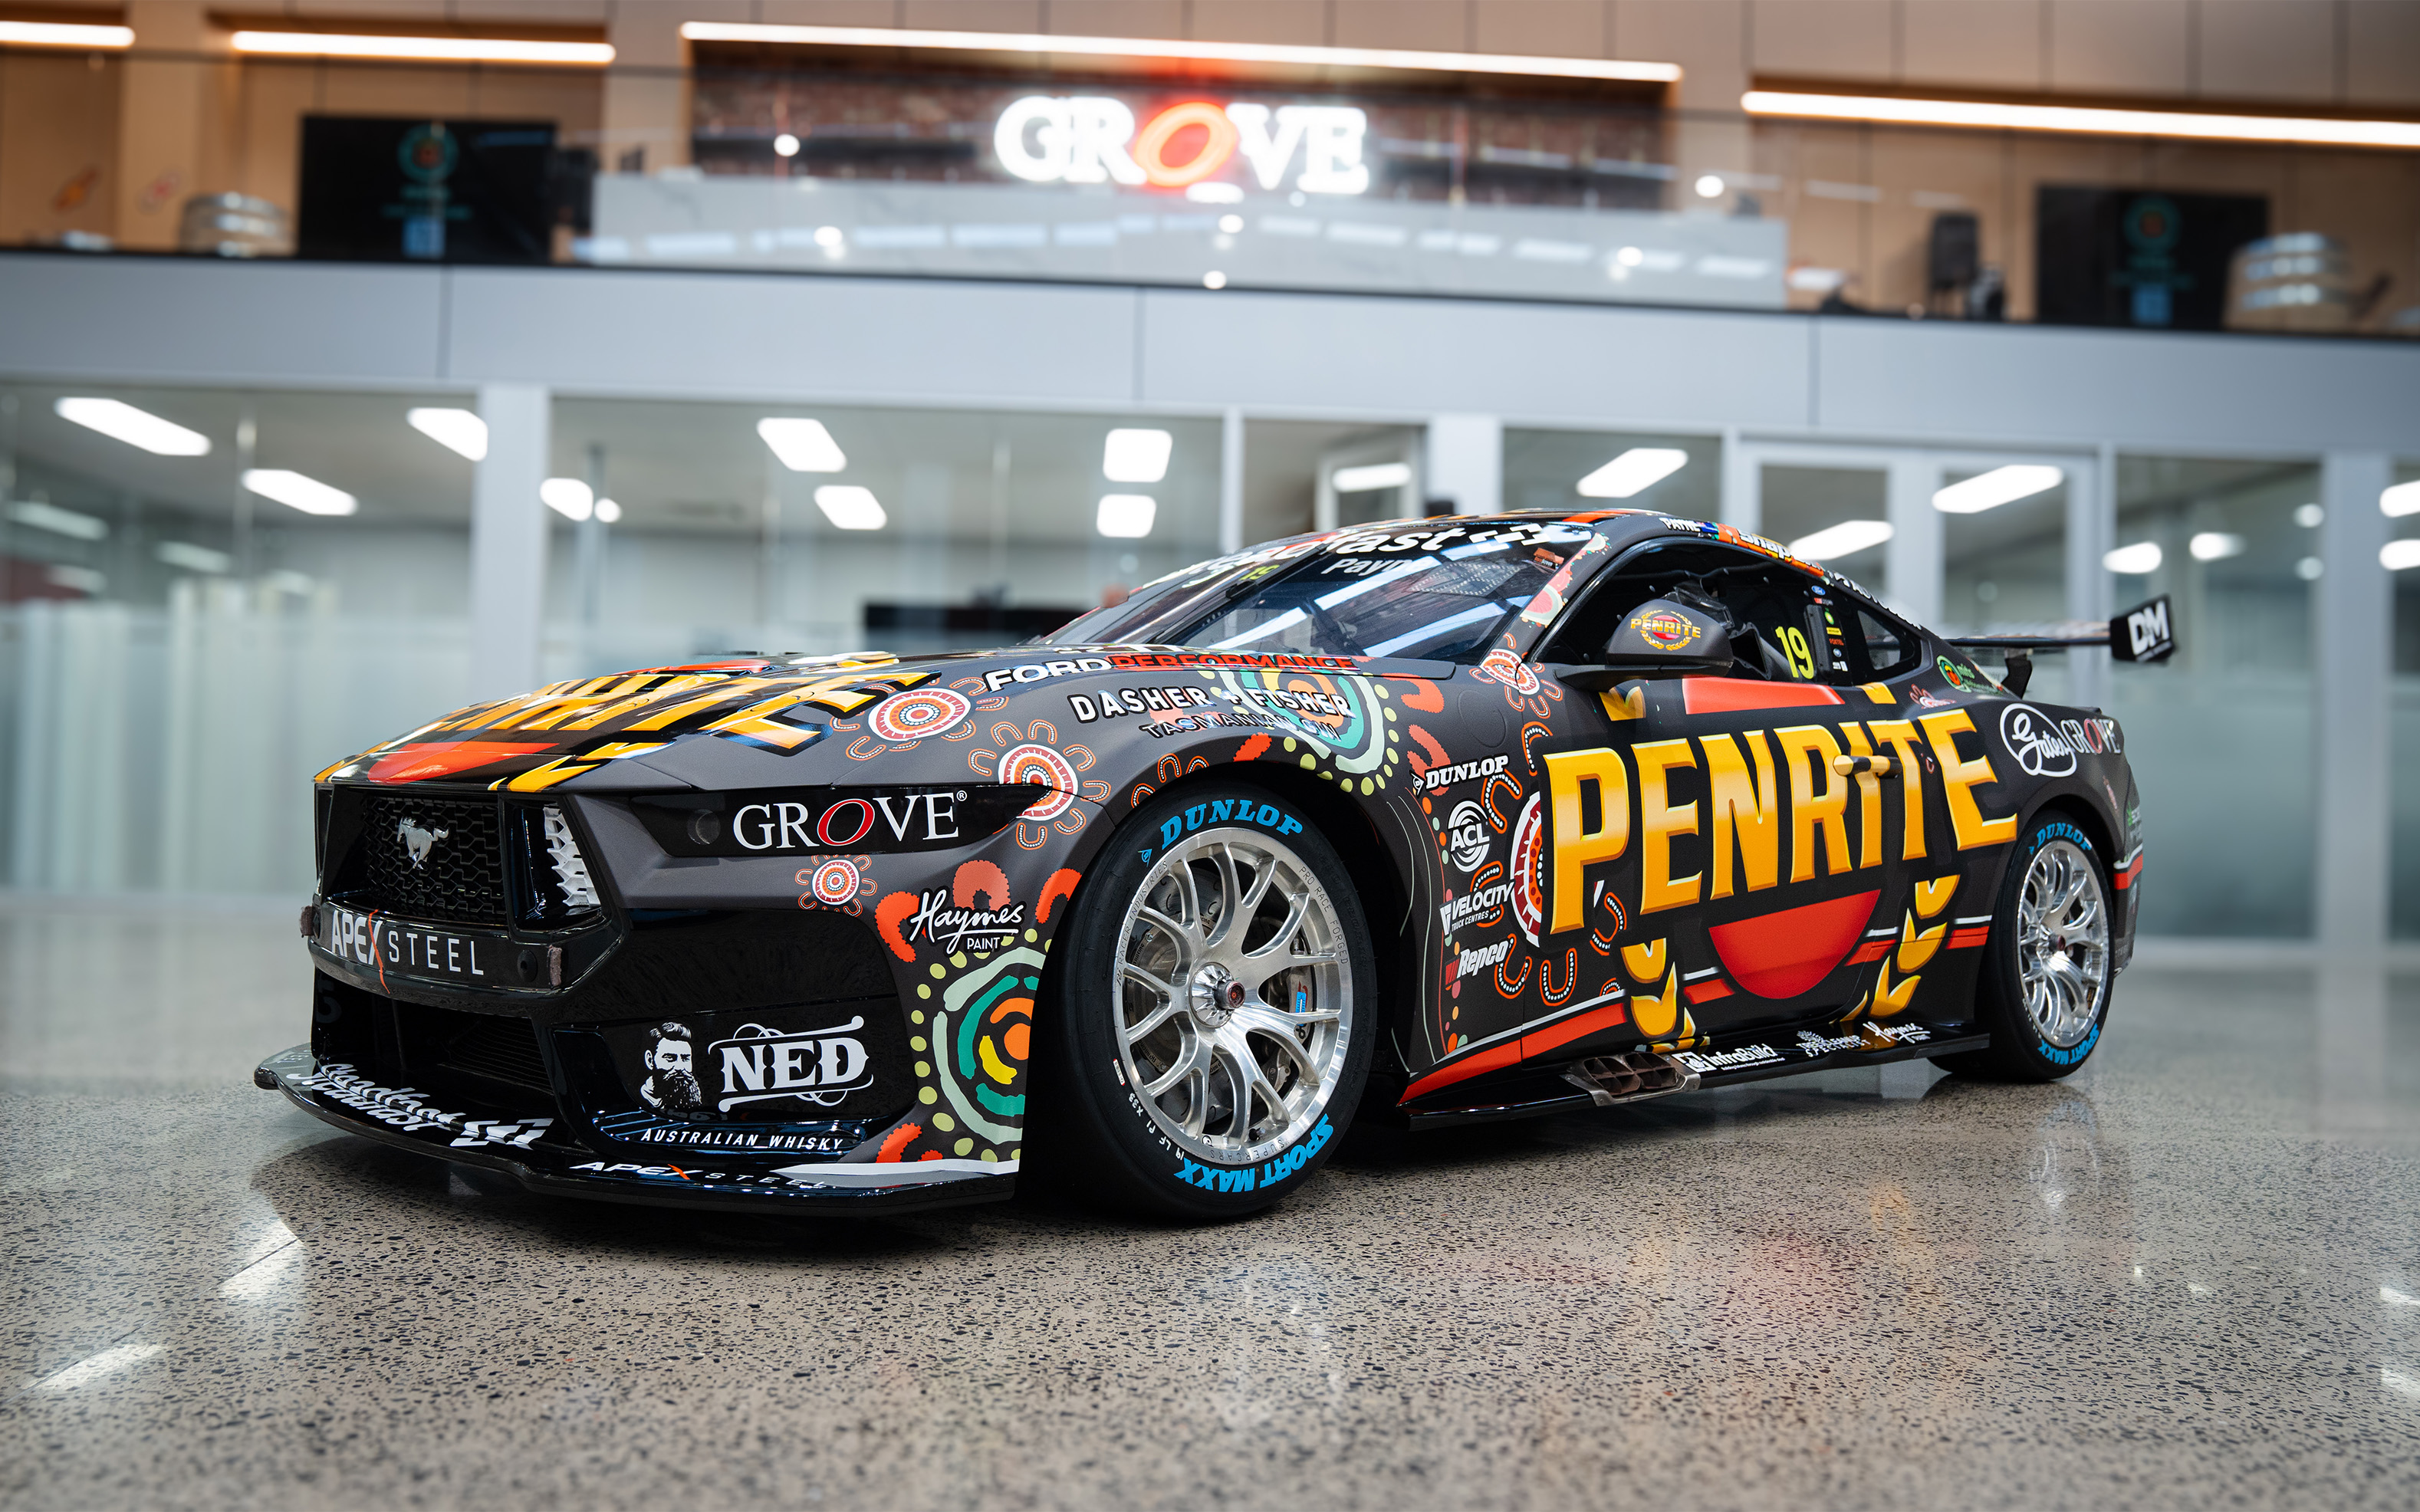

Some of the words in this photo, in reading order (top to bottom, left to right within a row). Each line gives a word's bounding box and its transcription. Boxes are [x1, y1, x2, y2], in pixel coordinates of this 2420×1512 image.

[995, 95, 1369, 194] GROVE
[1630, 617, 1702, 639] PENRITE
[2128, 600, 2169, 656] DM
[1776, 625, 1815, 679] 19
[985, 657, 1112, 692] FORD
[1113, 654, 1354, 672] PERFORMANCE
[1067, 685, 1212, 723] DASHER
[1248, 687, 1357, 718] FISHER
[1139, 712, 1296, 738] TASMANIAN
[1298, 718, 1342, 741] GIN
[2060, 718, 2122, 754] GROVE
[1425, 755, 1509, 790] DUNLOP
[1161, 799, 1303, 850] DUNLOP
[1450, 823, 1490, 852] ACL
[1544, 708, 2018, 934] PENRITE
[2036, 822, 2092, 851] DUNLOP
[1119, 926, 1131, 965] RACER
[1129, 860, 1168, 921] INDUSTRIES
[1299, 866, 1315, 886] PRO
[1314, 887, 1333, 913] RACE
[1330, 920, 1350, 965] FORGED
[1452, 882, 1514, 920] VELOCITY
[1465, 911, 1489, 927] CENTRES
[910, 889, 1024, 955] Haymes
[332, 909, 388, 988] APEX
[389, 930, 484, 976] STEEL
[967, 937, 1001, 950] PAINT
[1457, 940, 1509, 978] Repco
[720, 1037, 870, 1093] NED
[1701, 1043, 1778, 1067] InfraBuild
[2037, 1039, 2070, 1065] MAXX
[1128, 1092, 1145, 1117] X33
[640, 1128, 759, 1147] AUSTRALIAN
[769, 1133, 845, 1151] WHISKY
[1159, 1136, 1172, 1152] LF
[1175, 1146, 1185, 1161] 19
[1209, 1139, 1285, 1162] SUPERCARS
[1258, 1113, 1334, 1192] SPORT
[570, 1161, 703, 1181] APEX
[704, 1171, 837, 1190] STEEL
[1173, 1156, 1256, 1194] MAXX
